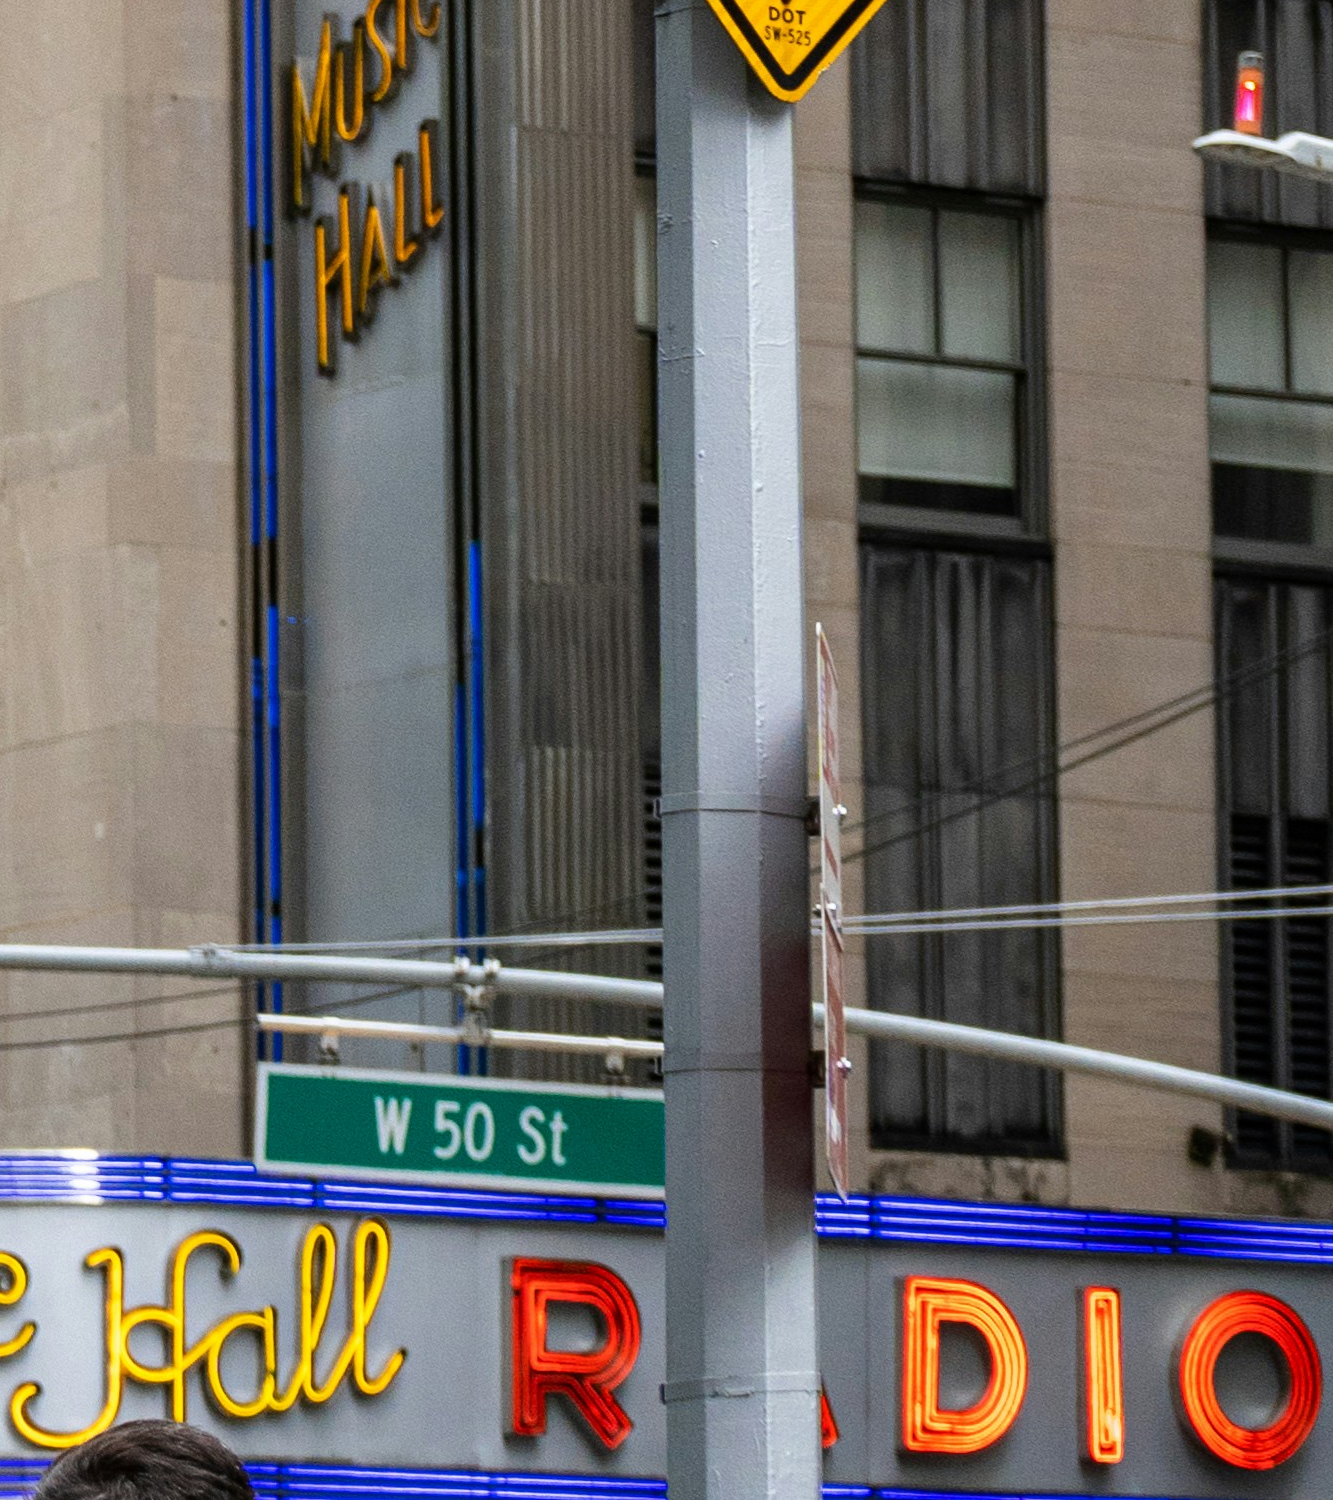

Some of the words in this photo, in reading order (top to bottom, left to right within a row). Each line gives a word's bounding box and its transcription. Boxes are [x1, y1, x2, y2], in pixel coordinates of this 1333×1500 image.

[764, 25, 812, 47] SW-525
[769, 6, 806, 25] DOT
[312, 119, 444, 374] HALL
[374, 1095, 412, 1156] W
[432, 1099, 495, 1162] 50
[517, 1105, 568, 1167] St
[10, 1219, 407, 1449] Hall
[511, 1256, 1324, 1471] RDIO
